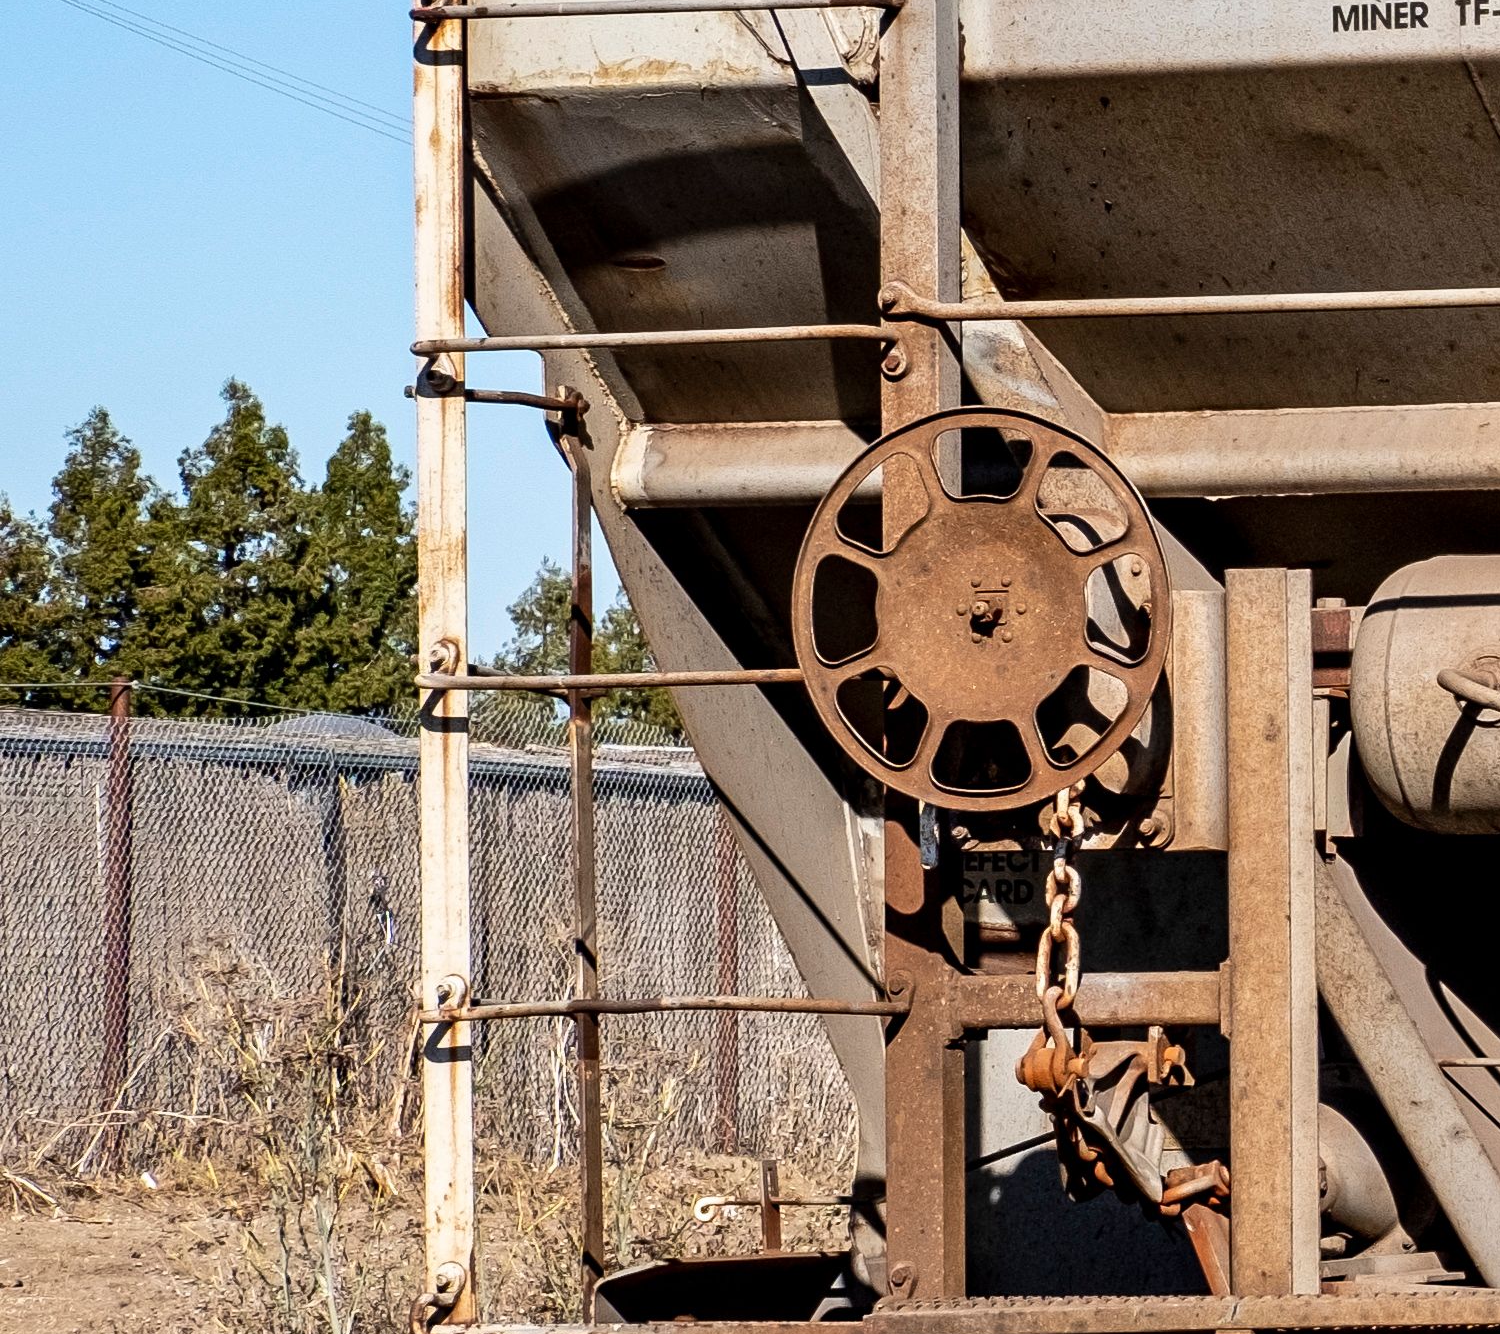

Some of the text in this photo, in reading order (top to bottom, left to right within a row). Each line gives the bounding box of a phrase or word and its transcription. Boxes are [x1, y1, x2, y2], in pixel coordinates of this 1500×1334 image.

[1332, 0, 1429, 33] MINER
[962, 852, 1040, 872] EFECT
[961, 879, 1034, 904] CARD
